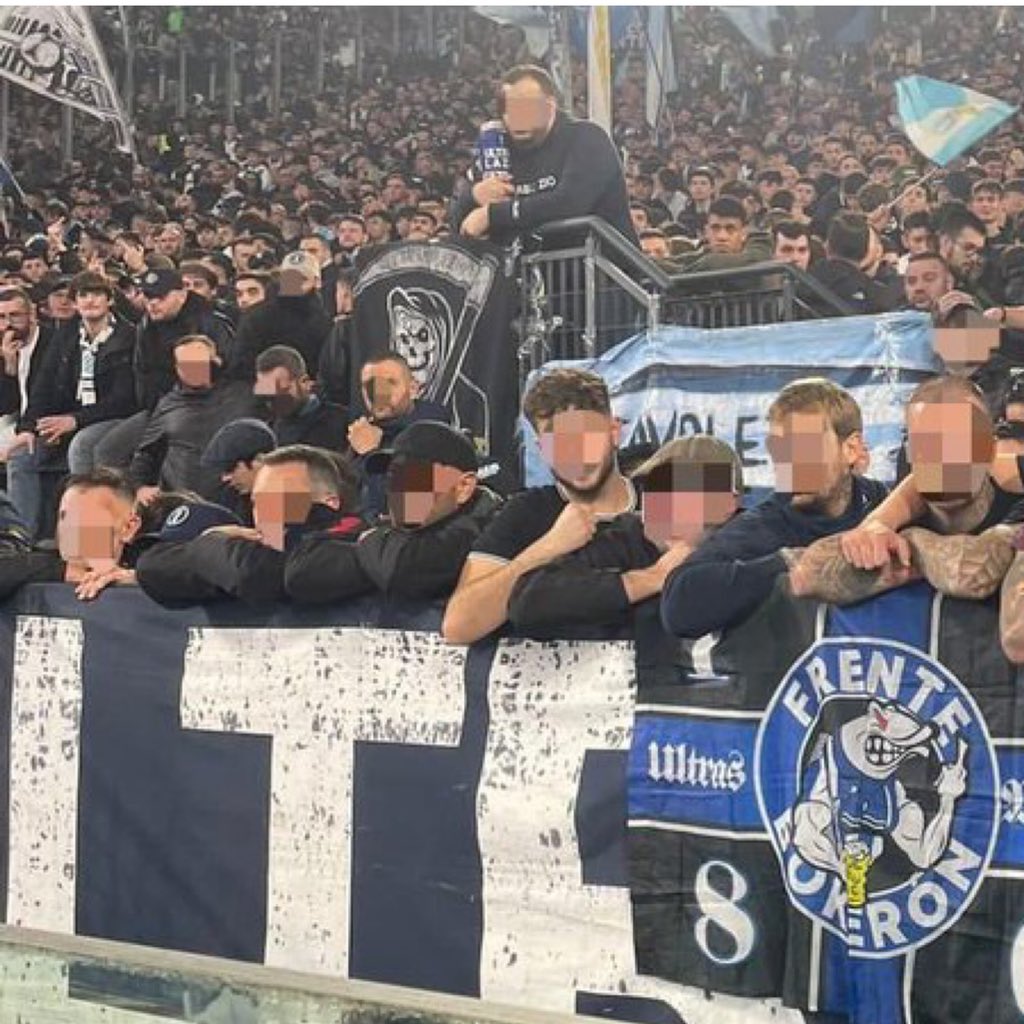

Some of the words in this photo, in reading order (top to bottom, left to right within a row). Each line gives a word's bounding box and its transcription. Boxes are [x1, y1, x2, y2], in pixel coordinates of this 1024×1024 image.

[782, 648, 973, 745] FRENTE
[648, 742, 747, 792] Ultras
[694, 859, 755, 964] 8
